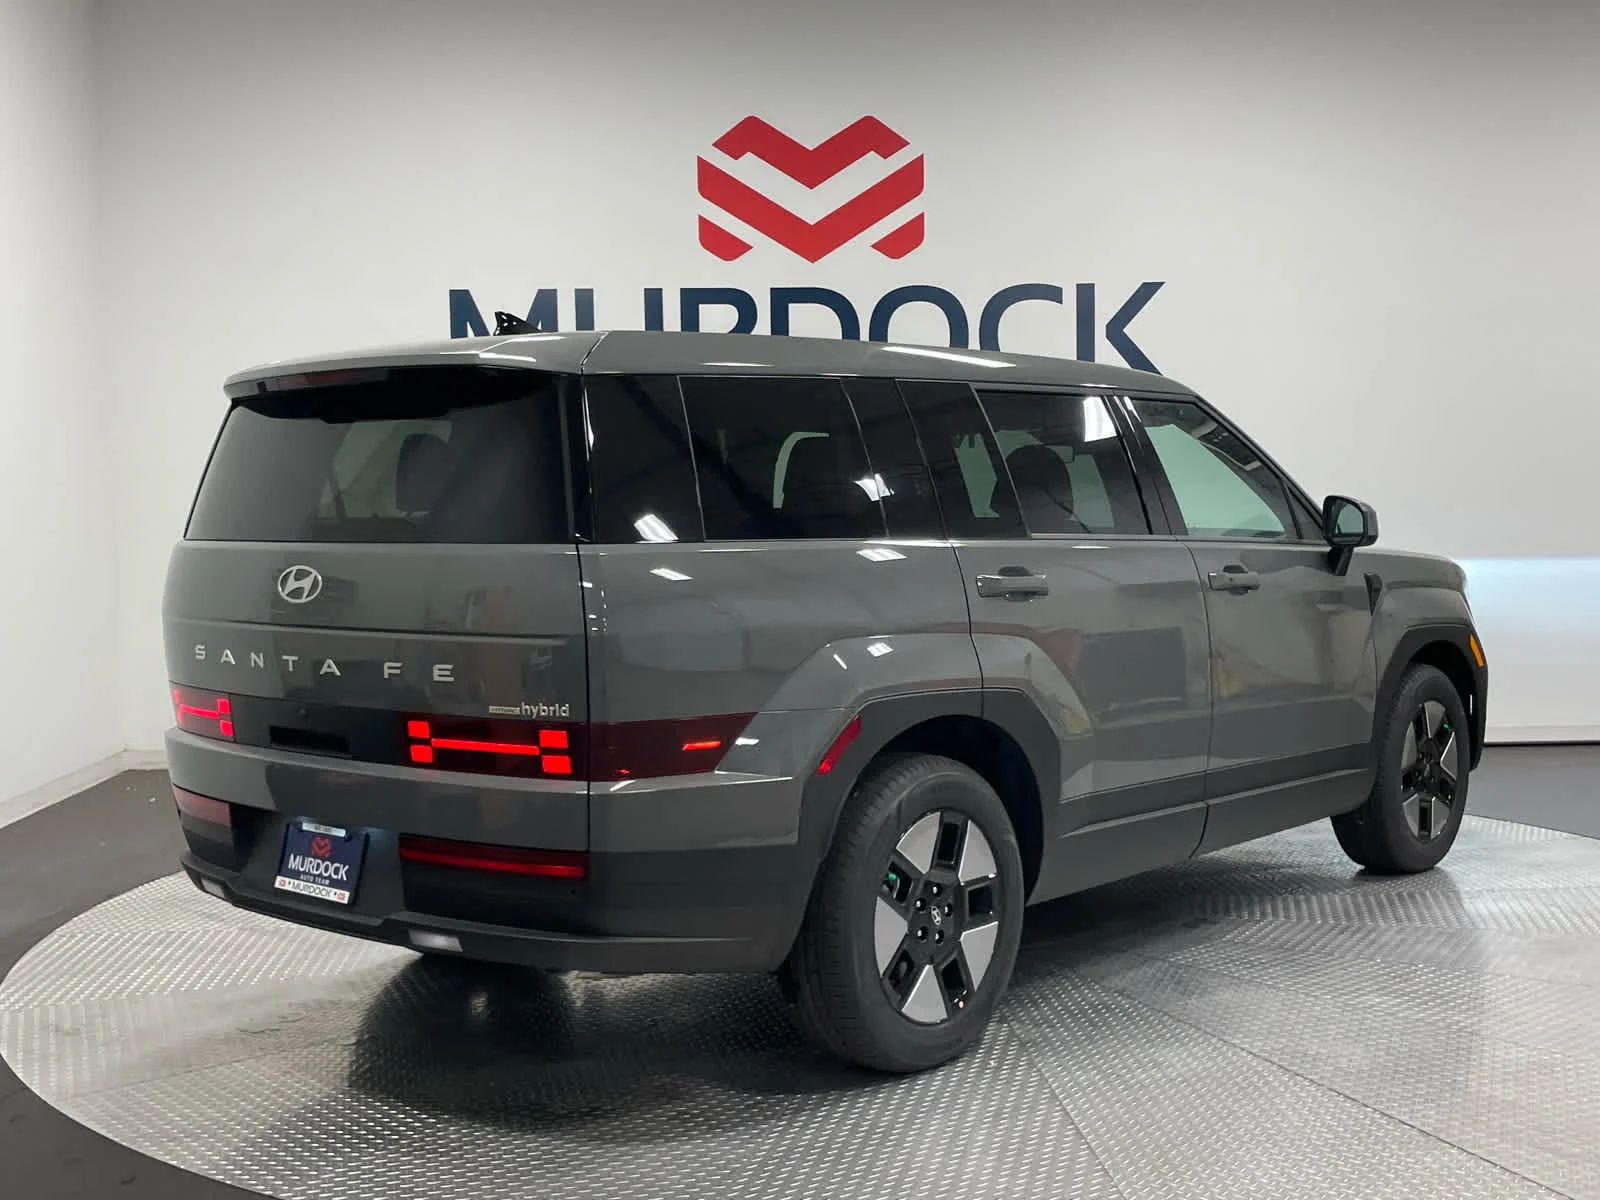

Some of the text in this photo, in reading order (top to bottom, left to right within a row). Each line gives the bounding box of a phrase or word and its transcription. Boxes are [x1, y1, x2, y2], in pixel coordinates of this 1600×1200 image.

[195, 644, 456, 682] SANTA FE
[521, 702, 570, 719] hybrid
[288, 853, 349, 881] MURDOCK
